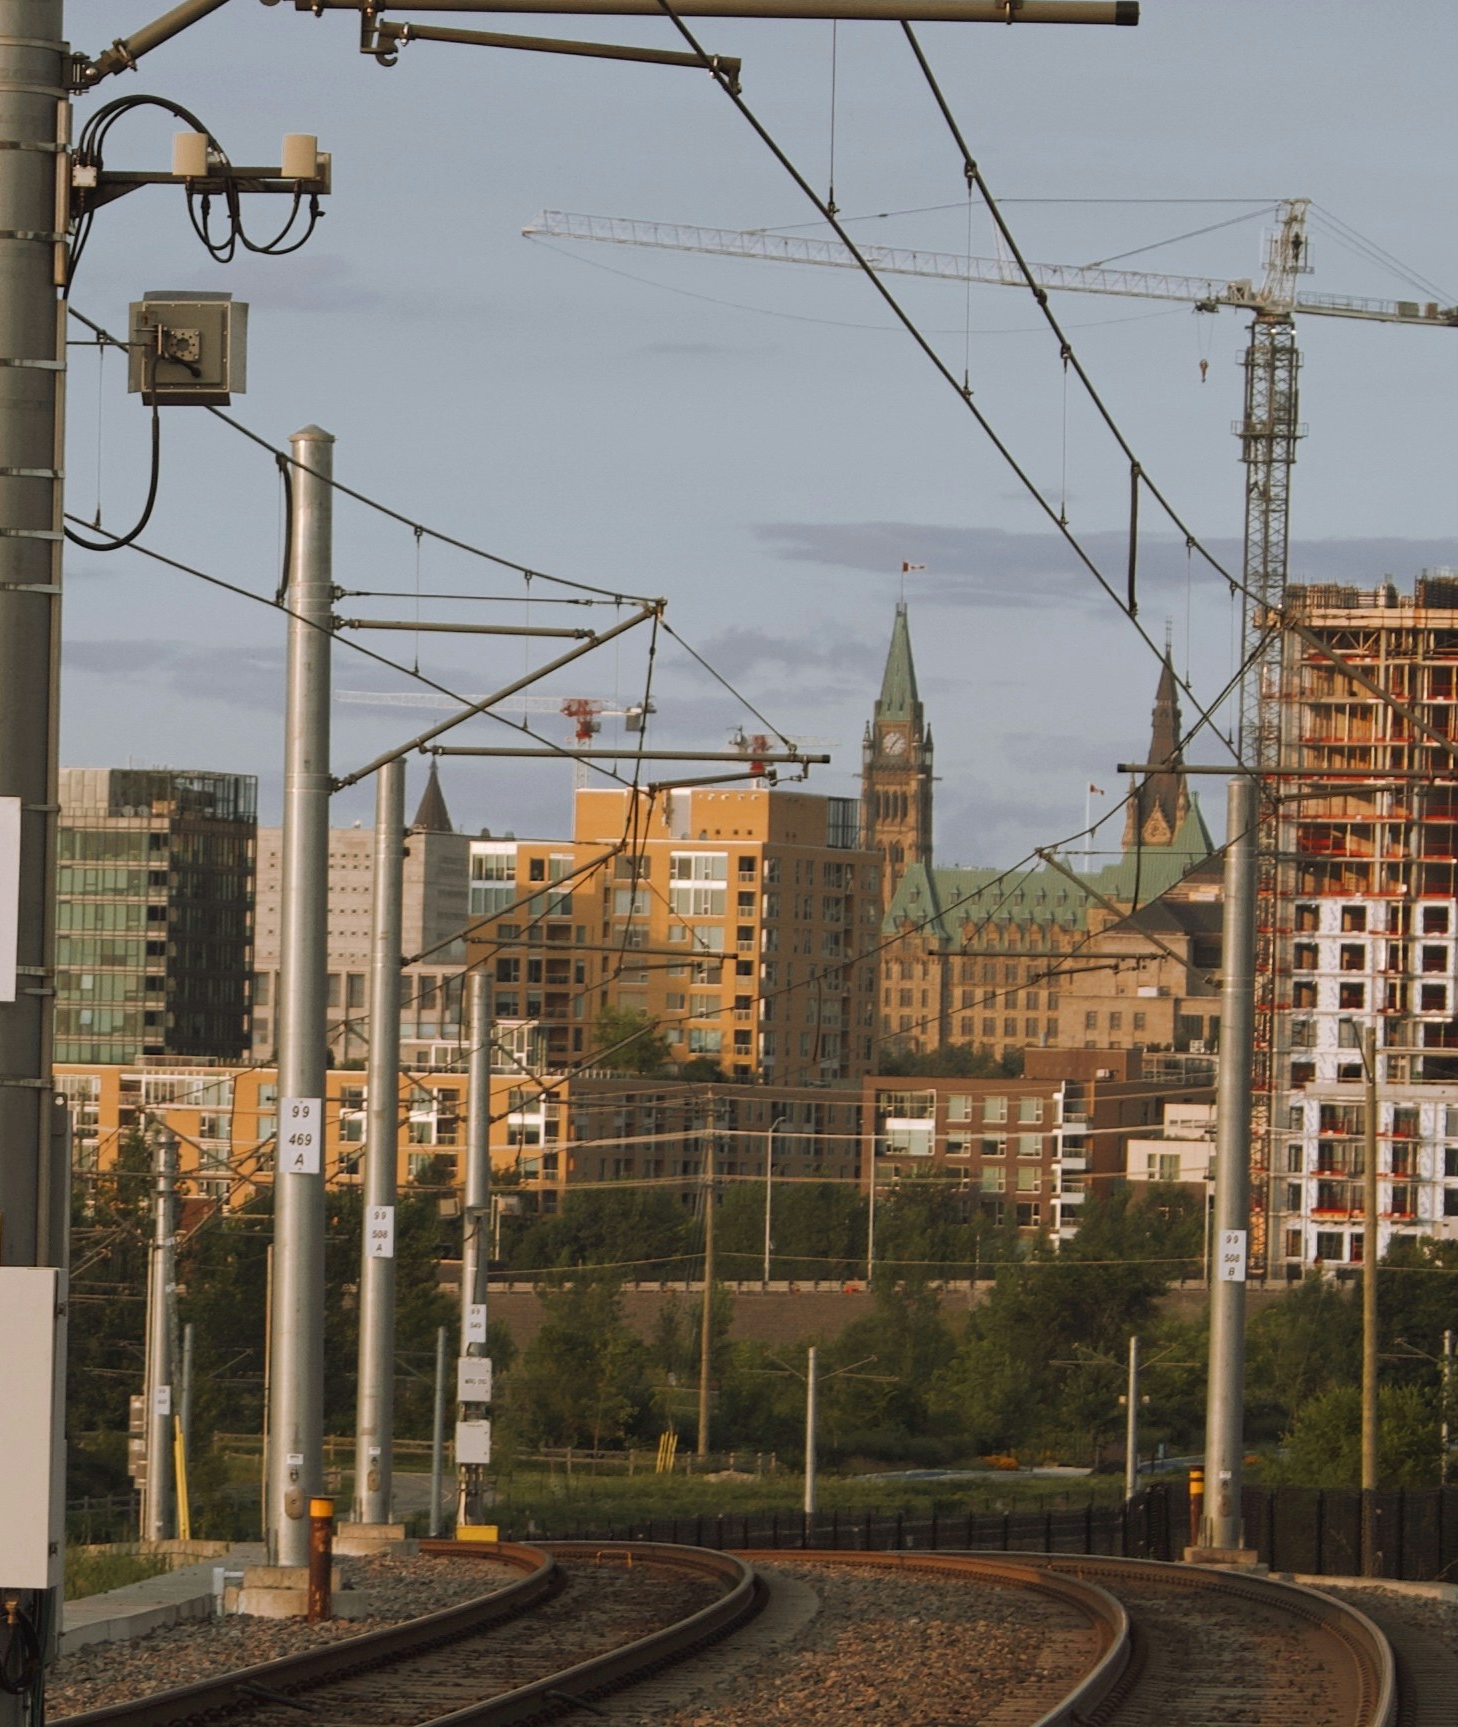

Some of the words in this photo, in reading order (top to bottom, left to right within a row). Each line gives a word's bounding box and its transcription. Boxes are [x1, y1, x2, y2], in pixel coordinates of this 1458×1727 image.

[292, 1105, 310, 1118] 99
[289, 1133, 313, 1146] 469
[295, 1153, 304, 1165] A
[374, 1210, 387, 1220] 99
[1226, 1235, 1239, 1244] 99
[375, 1243, 383, 1252] A
